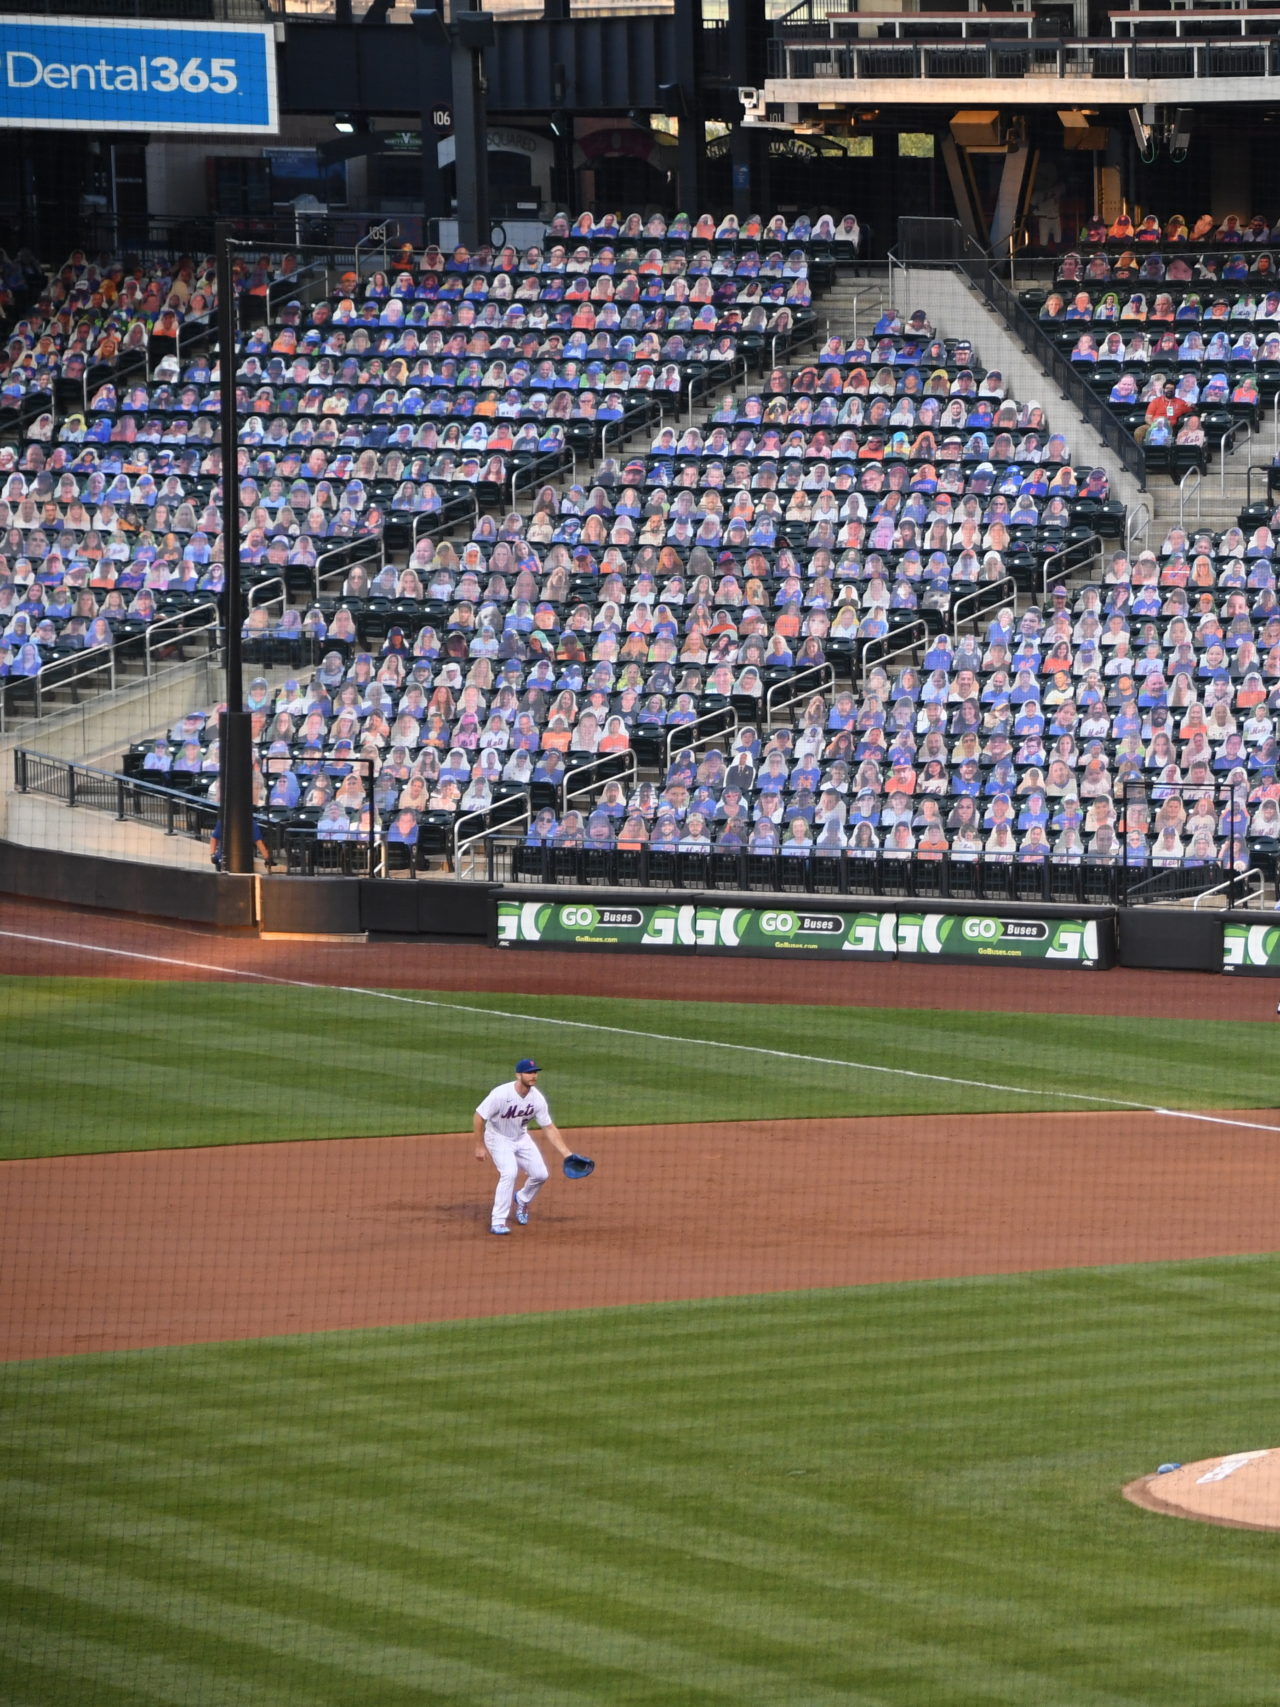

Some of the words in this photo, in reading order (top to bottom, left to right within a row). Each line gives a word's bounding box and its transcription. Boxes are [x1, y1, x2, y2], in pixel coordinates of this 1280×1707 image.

[6, 51, 238, 94] Dental365
[433, 110, 451, 126] 106
[486, 130, 537, 153] SQUARED
[1183, 435, 1200, 444] Mets
[561, 907, 593, 926] GO
[603, 912, 632, 922] Buses
[761, 913, 793, 932] GO
[803, 918, 834, 929] Buses
[964, 918, 996, 938] GO
[1007, 924, 1038, 936] Buses
[575, 935, 618, 943] GoBuses.com
[977, 947, 1022, 956] GoBuses.com
[501, 1104, 536, 1119] Mets
